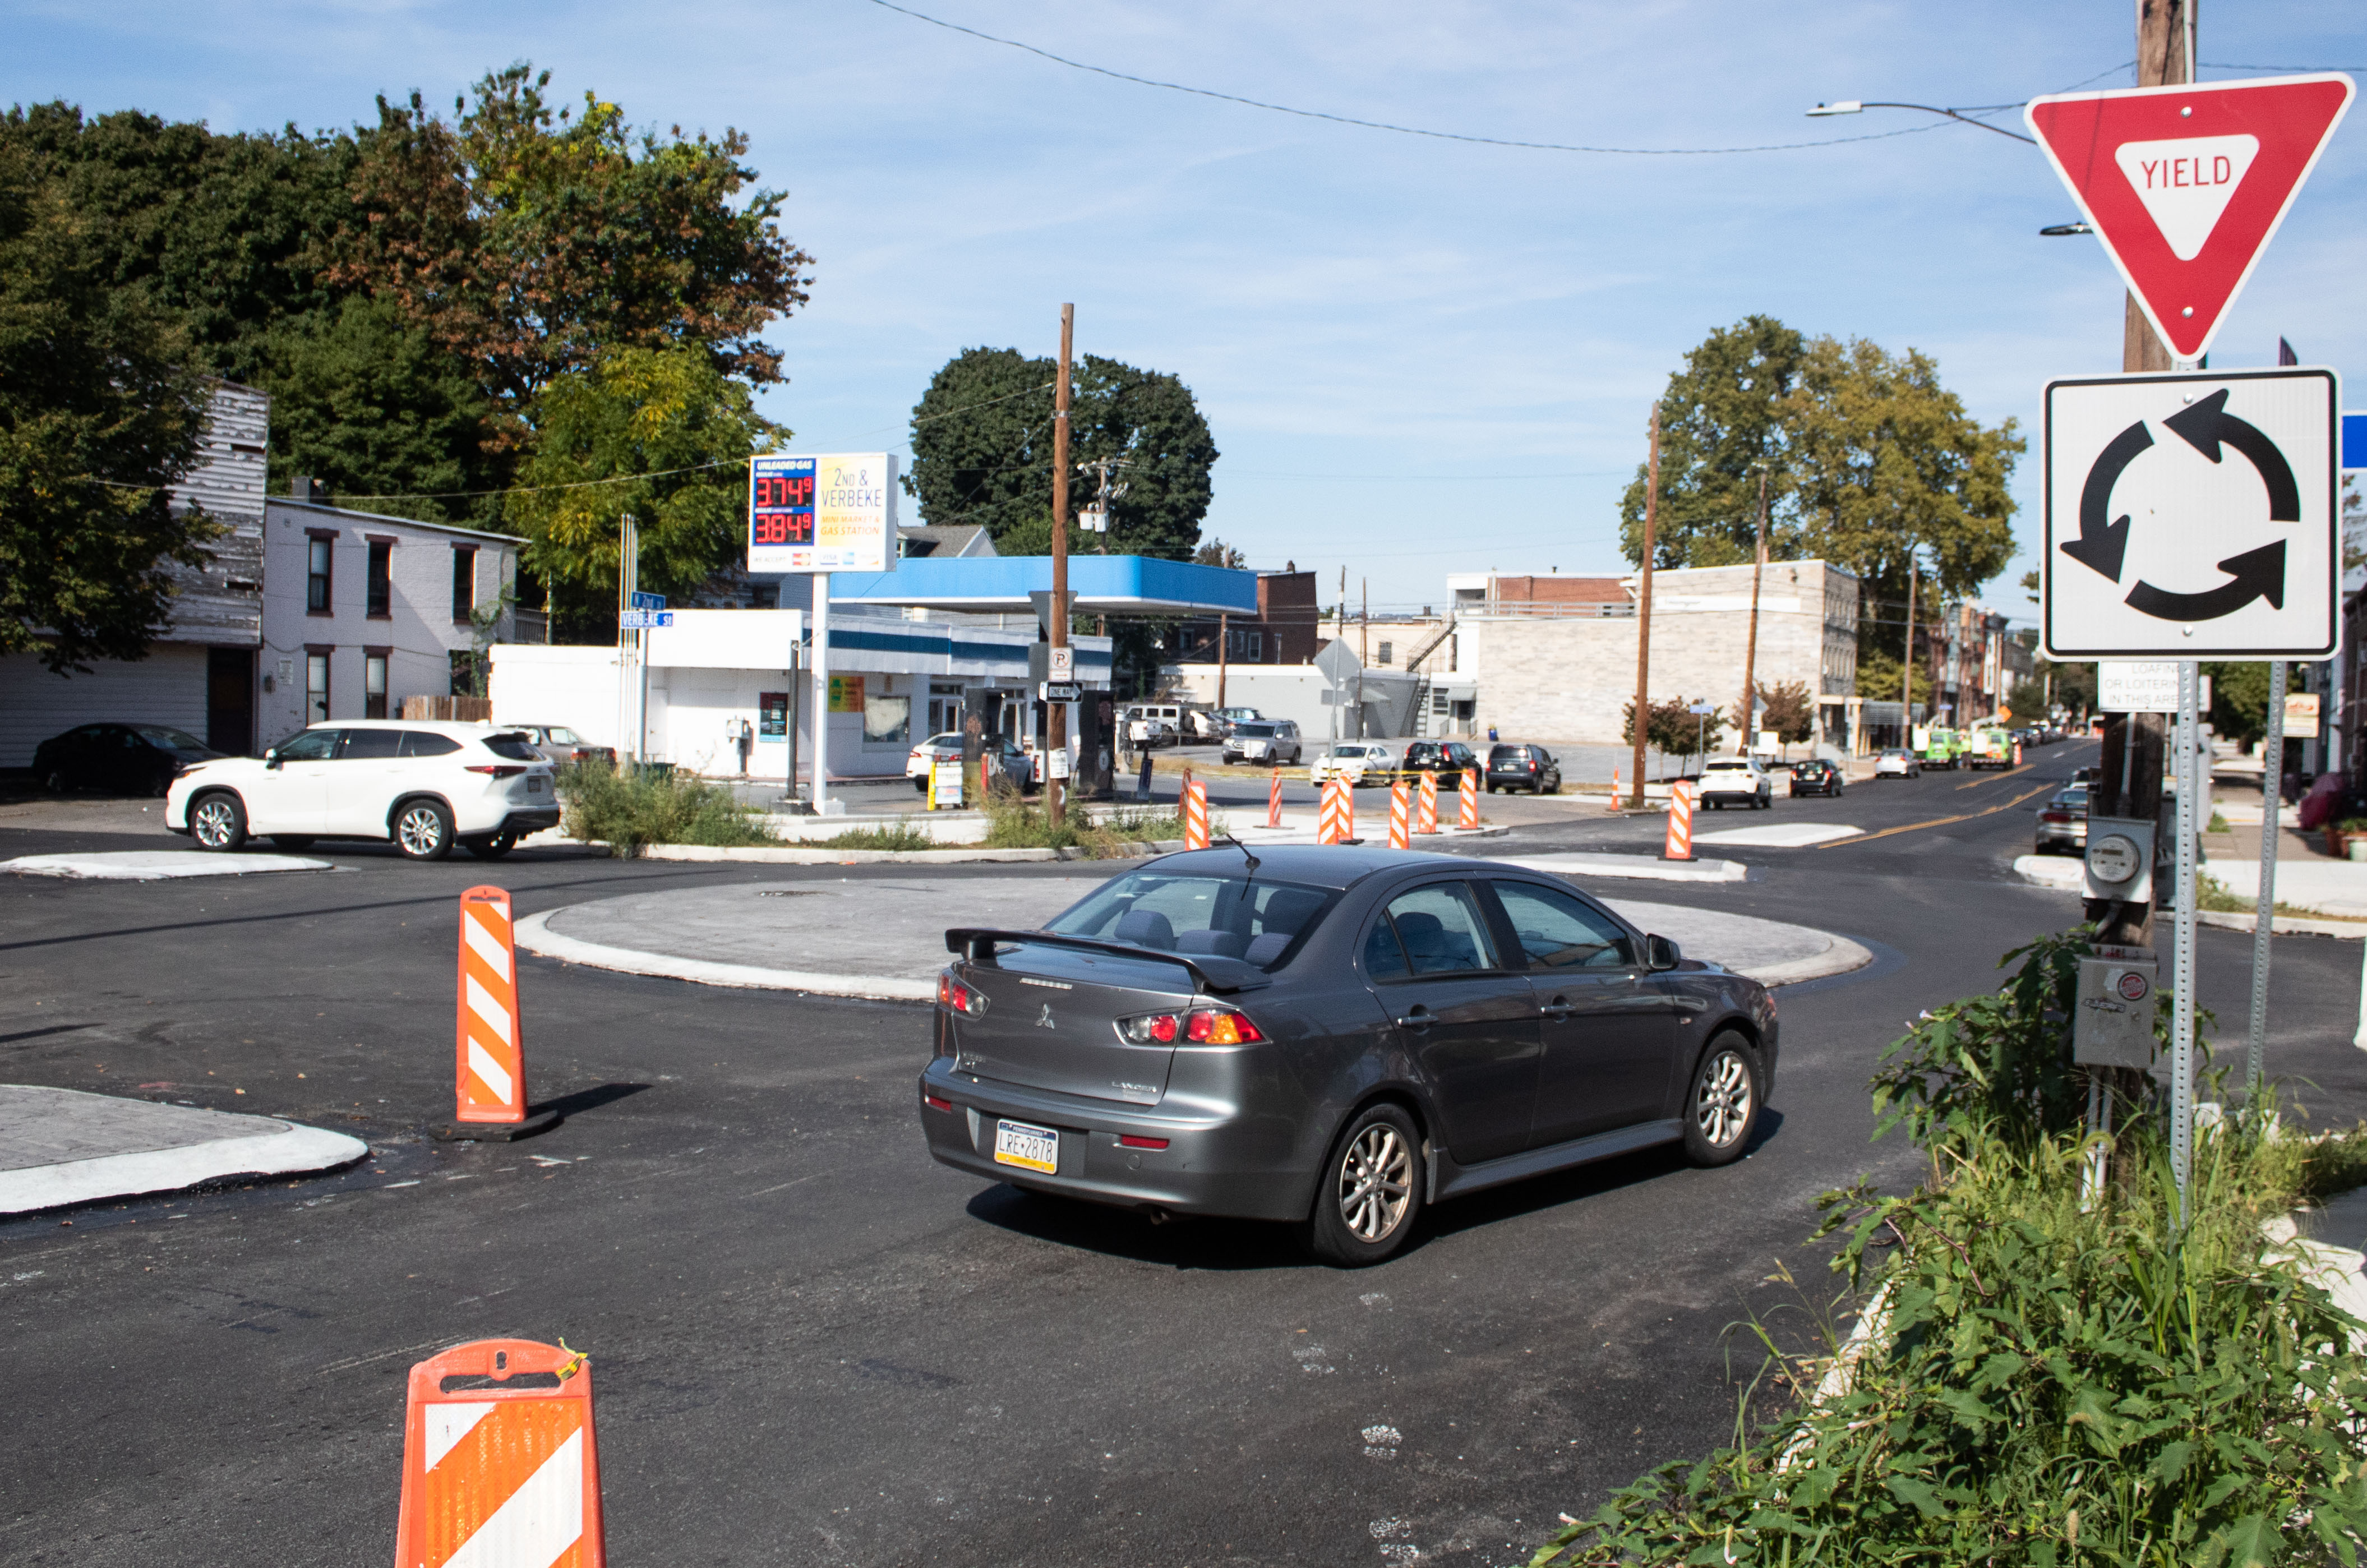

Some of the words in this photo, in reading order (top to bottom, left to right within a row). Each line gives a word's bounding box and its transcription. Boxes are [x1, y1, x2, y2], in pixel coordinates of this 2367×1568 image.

[2141, 155, 2231, 190] YIELD
[757, 460, 796, 470] UNLEADED
[797, 460, 813, 469] GAS
[859, 469, 868, 486] &
[821, 489, 882, 508] VERBEKE
[821, 526, 838, 536] GAS
[841, 526, 879, 536] STATION
[2131, 664, 2178, 674] LOAFIN
[2105, 679, 2122, 689] OR
[2125, 679, 2178, 689] LOITERIN
[2108, 695, 2121, 704] IN
[2124, 695, 2151, 704] THIS
[2154, 695, 2178, 704] ARE
